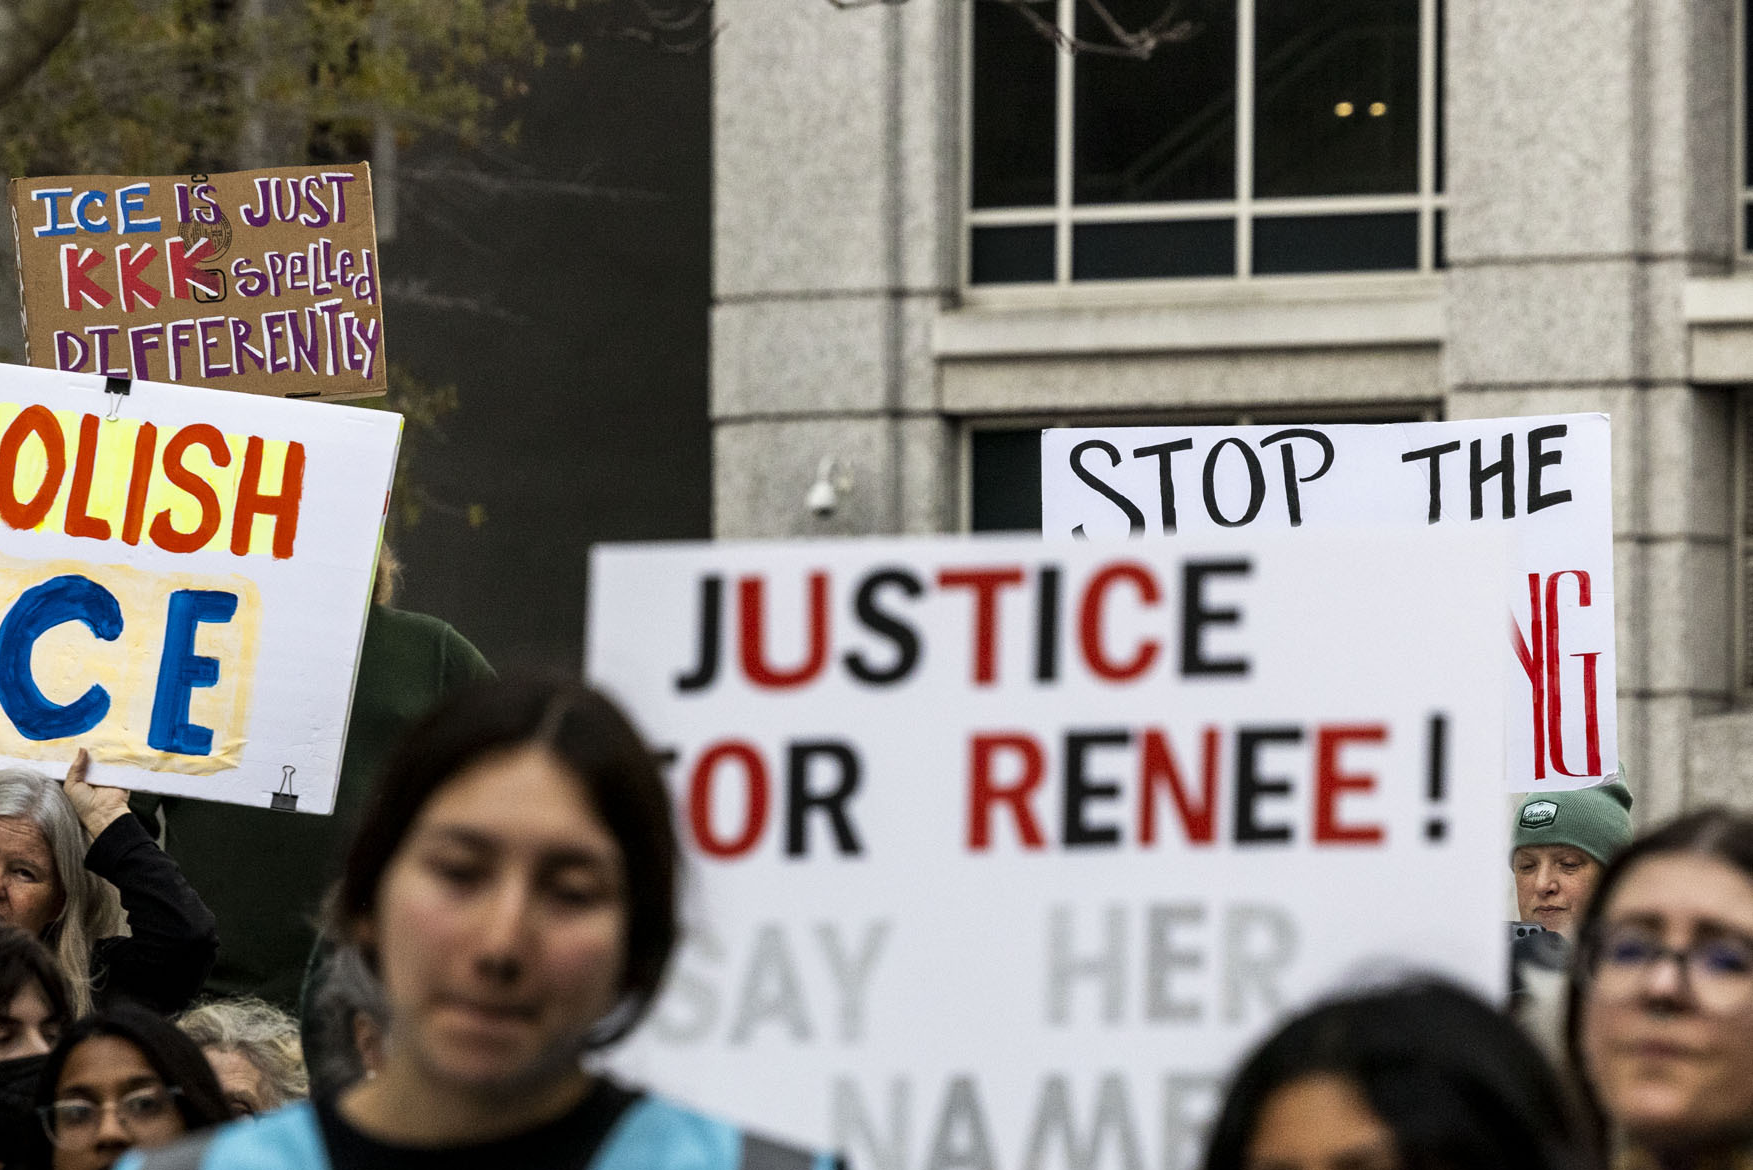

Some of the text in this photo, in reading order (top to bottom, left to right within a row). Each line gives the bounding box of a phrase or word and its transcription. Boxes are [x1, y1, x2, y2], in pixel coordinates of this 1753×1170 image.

[31, 182, 161, 237] ICE
[174, 183, 223, 224] IS
[240, 172, 354, 228] JUST
[60, 236, 220, 312] KKK
[53, 298, 380, 381] DIFFERENTLY
[1069, 424, 1572, 541] STOP THE
[675, 558, 1256, 693] JUSTICE
[651, 740, 864, 858] OR
[968, 722, 1389, 850] RENEE
[1047, 901, 1302, 1026] HER
